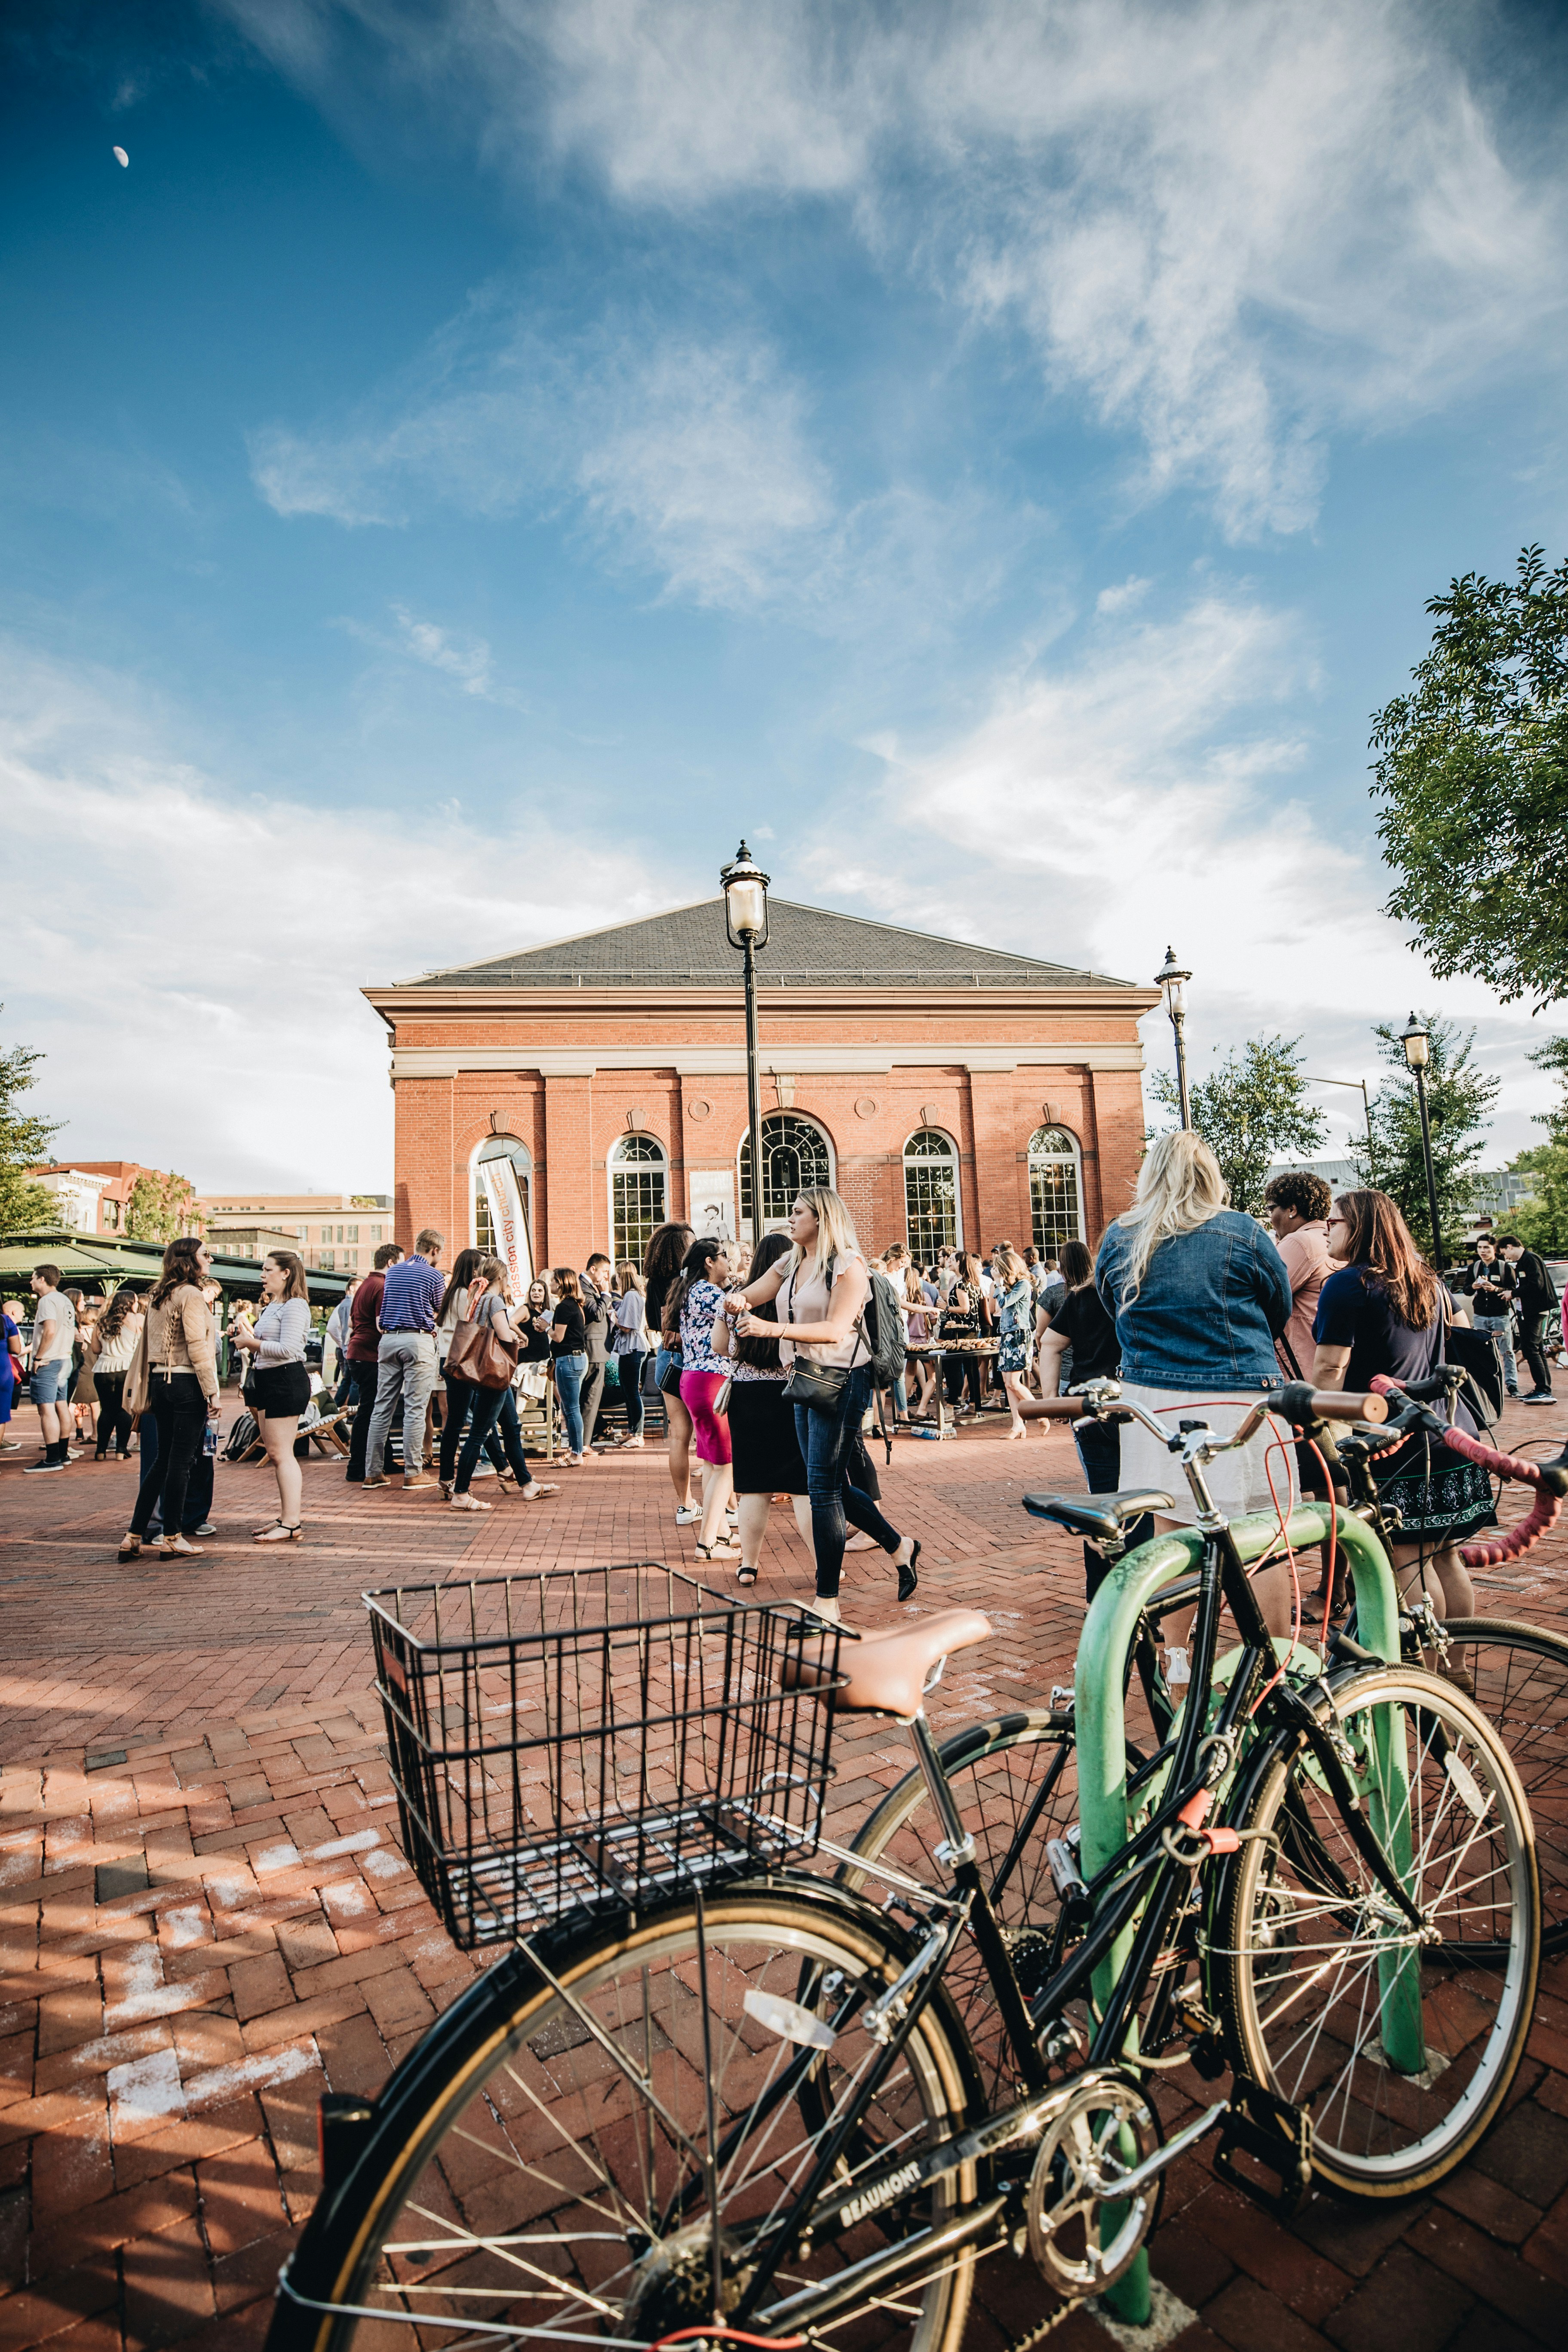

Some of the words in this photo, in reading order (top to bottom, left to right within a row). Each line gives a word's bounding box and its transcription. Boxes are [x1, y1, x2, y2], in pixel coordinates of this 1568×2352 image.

[491, 1173, 509, 1216] church
[503, 1220, 514, 1242] city
[506, 1245, 525, 1298] passion
[1376, 1427, 1406, 1447] BONTR
[840, 2161, 922, 2228] BEAUMONT
